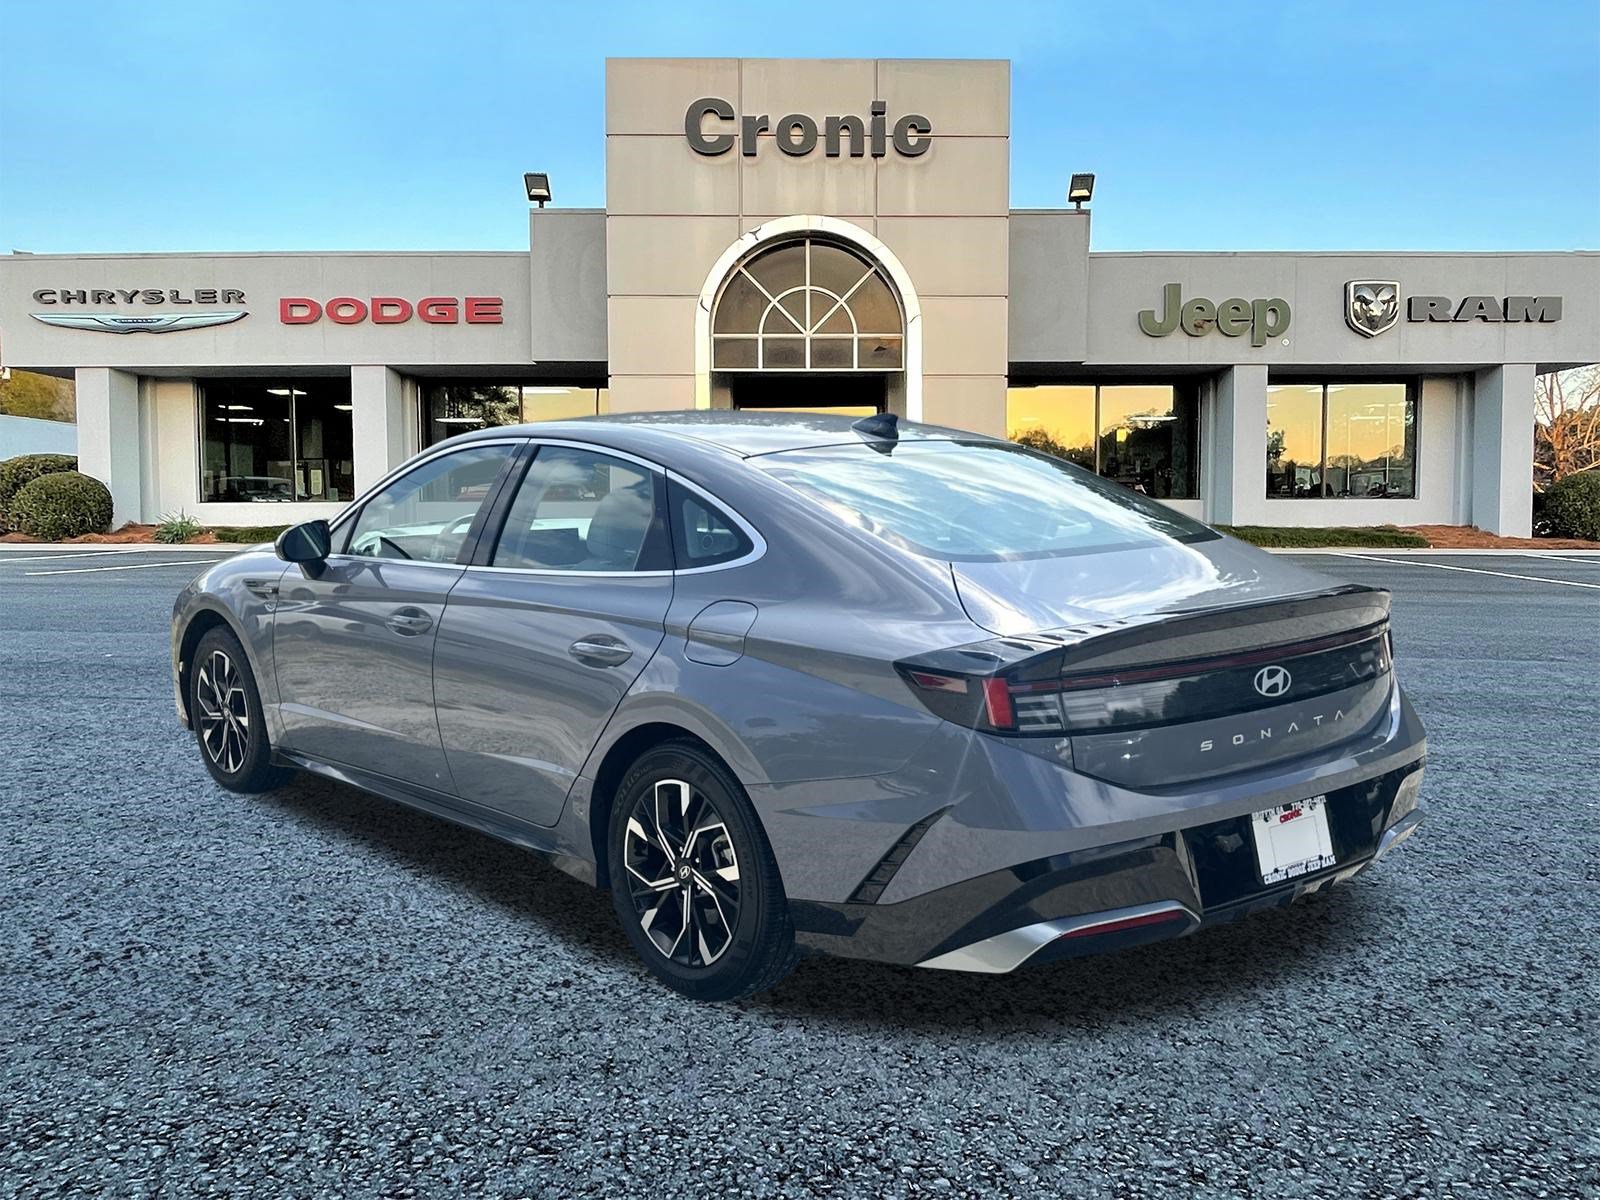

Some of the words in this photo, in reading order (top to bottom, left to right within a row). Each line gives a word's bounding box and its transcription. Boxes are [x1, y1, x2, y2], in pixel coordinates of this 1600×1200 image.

[684, 97, 932, 157] Cronic
[32, 288, 247, 305] CHRYSLER
[279, 297, 504, 325] DODGE
[1407, 296, 1563, 323] RAM
[1138, 283, 1291, 347] Jeep
[1200, 709, 1345, 752] SONATA
